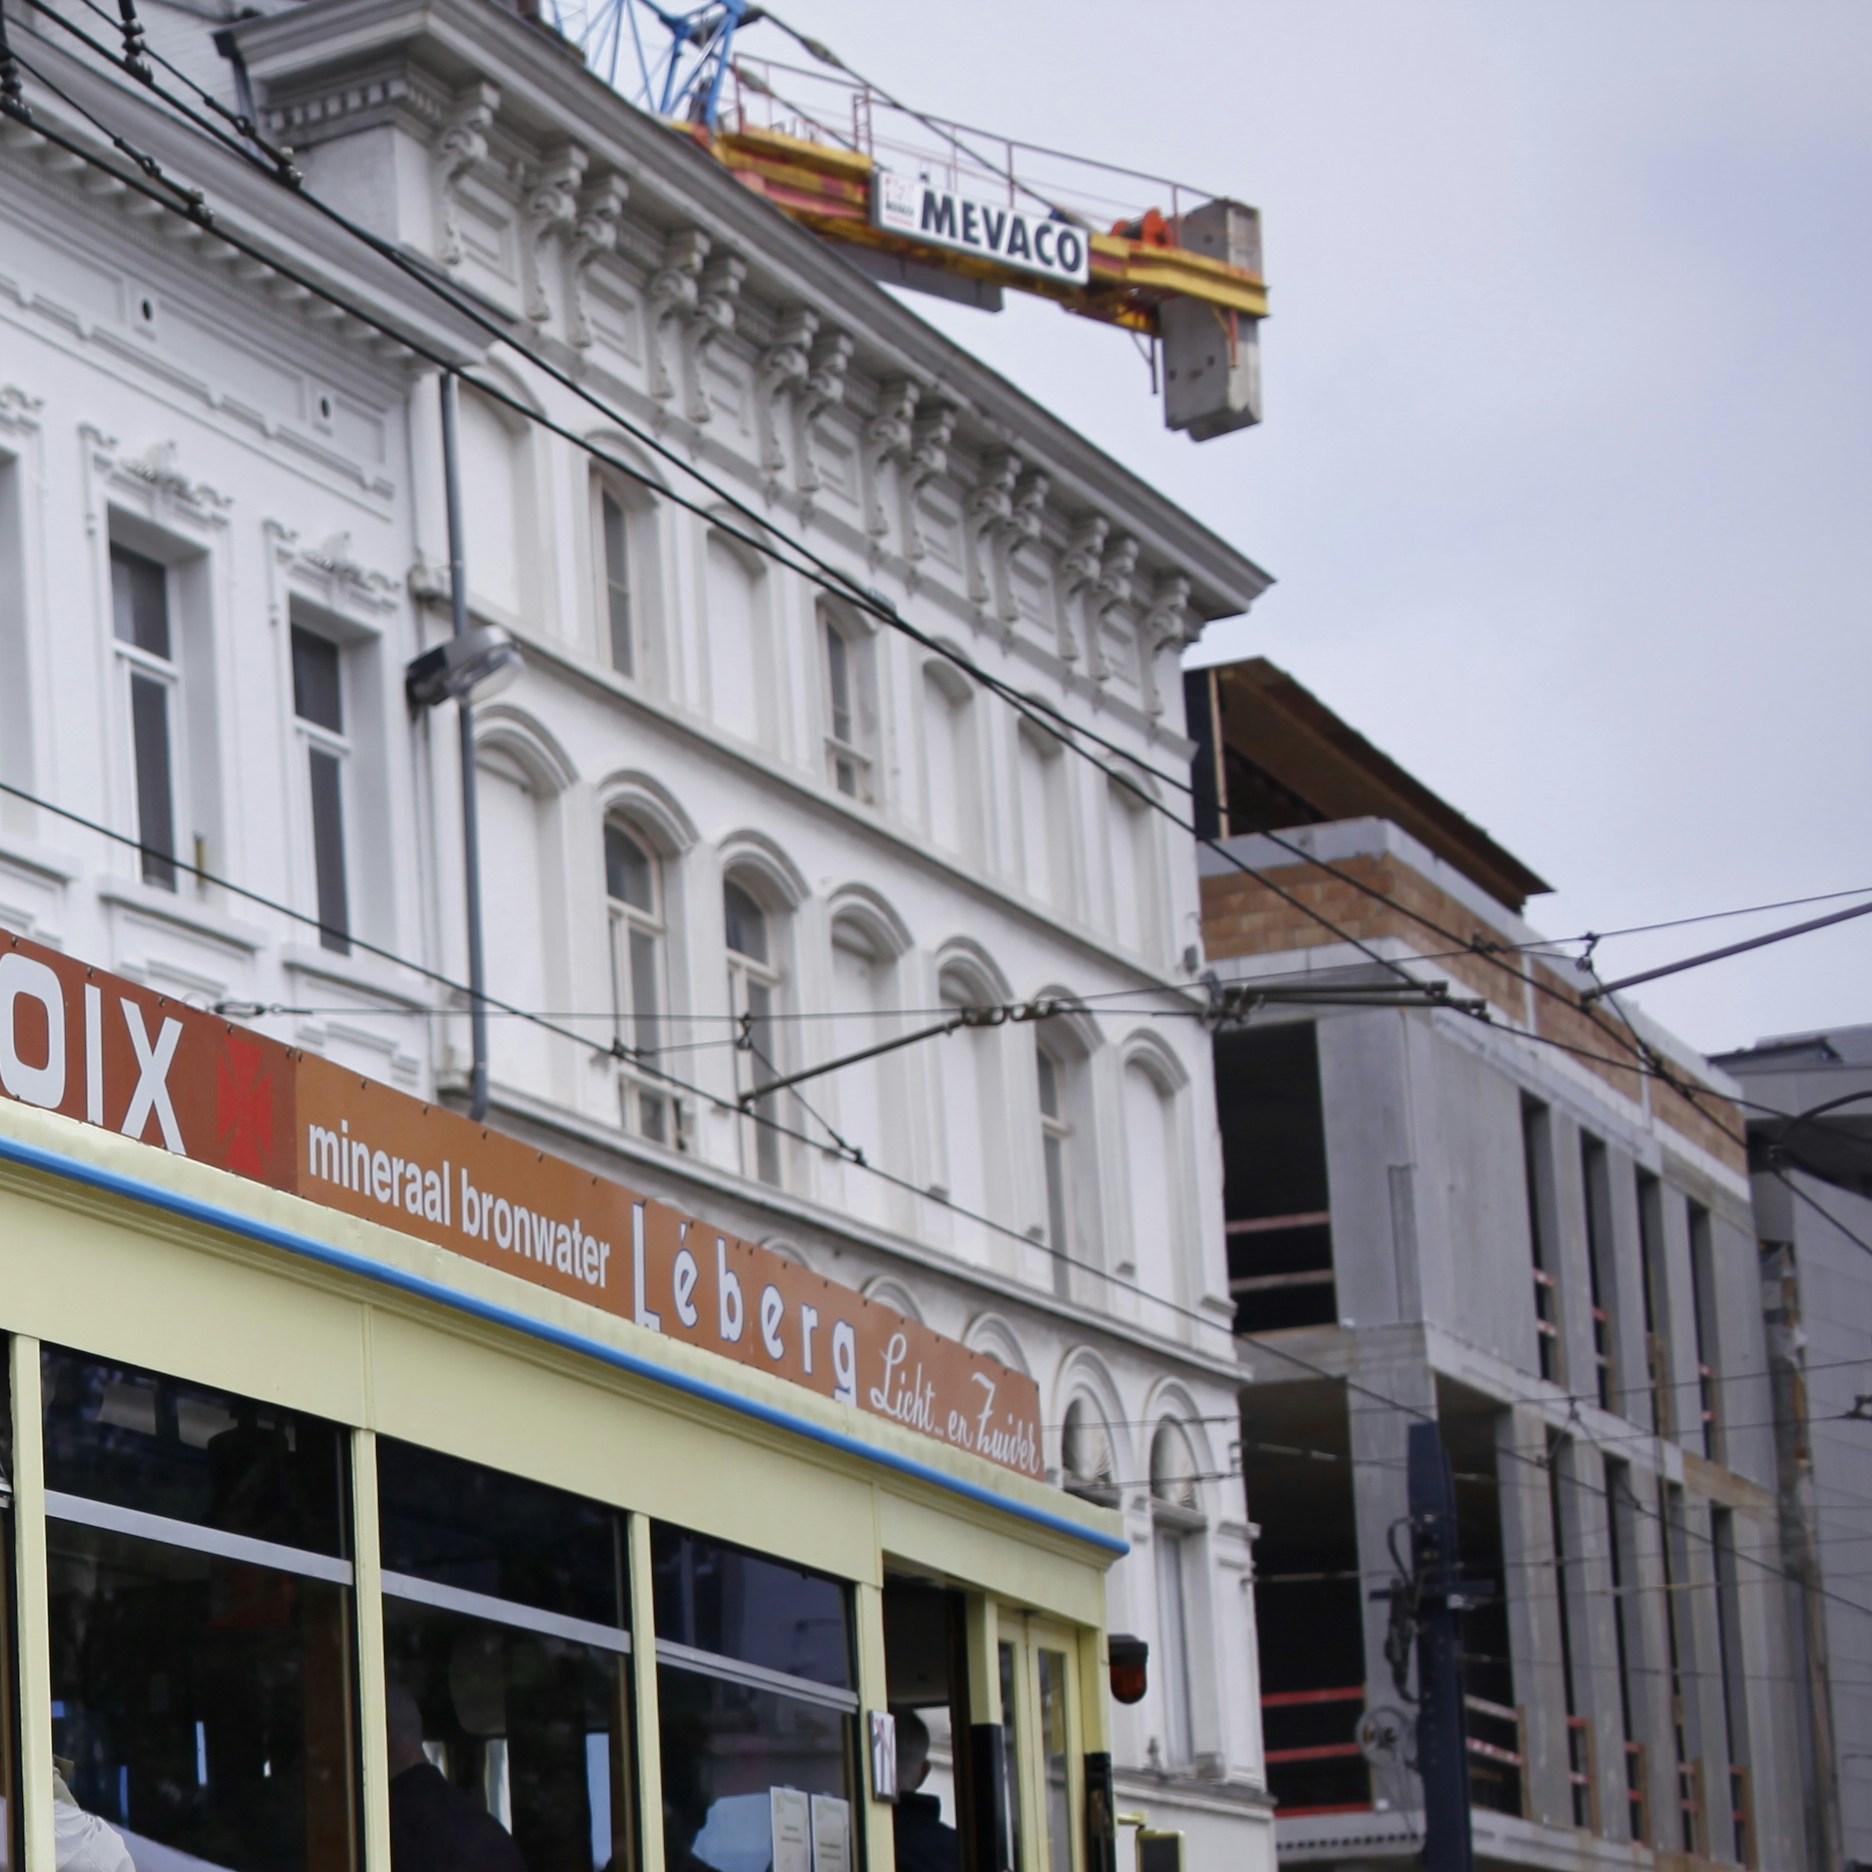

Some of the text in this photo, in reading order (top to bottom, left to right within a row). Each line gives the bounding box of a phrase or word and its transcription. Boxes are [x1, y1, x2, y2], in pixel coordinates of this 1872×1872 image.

[921, 189, 1081, 273] MEVACO
[308, 1118, 452, 1227] mineraal
[459, 1167, 611, 1290] bronwater
[632, 1202, 856, 1406] Léberg
[947, 1409, 974, 1448] en
